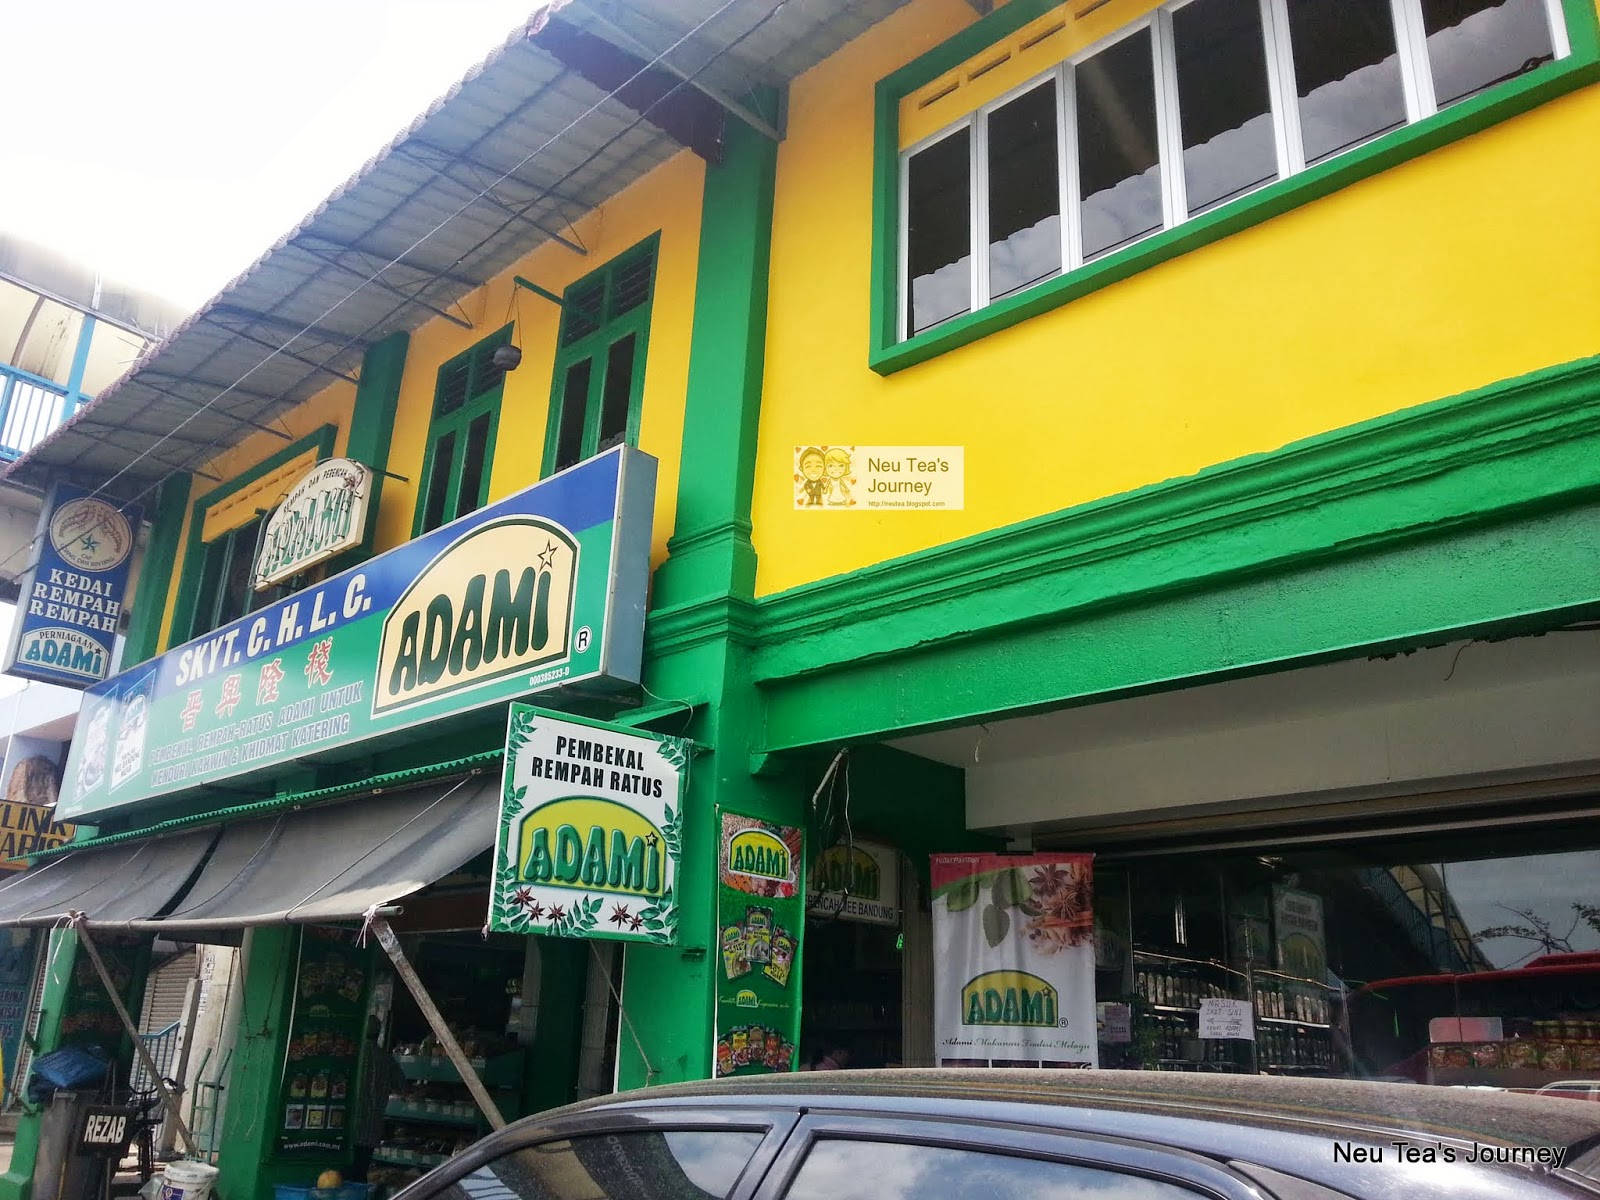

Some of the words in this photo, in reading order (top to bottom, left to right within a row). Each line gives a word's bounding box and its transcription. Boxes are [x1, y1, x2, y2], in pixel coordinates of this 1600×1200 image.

[308, 475, 320, 488] DAN
[33, 582, 120, 617] REMPAH
[49, 568, 113, 597] KEDAI
[28, 599, 117, 633] REMPAH
[389, 566, 551, 696] ADAMI
[25, 639, 102, 676] ADAMI
[39, 631, 95, 650] PERNIAGAAN
[279, 696, 315, 726] ADAMI
[320, 681, 363, 714] UNTUK
[231, 750, 239, 766] &
[241, 735, 288, 763] KHIDMAT
[291, 713, 350, 748] KATERING
[556, 735, 645, 771] PEMBEKAL
[531, 756, 605, 788] REMPAH
[609, 770, 663, 798] RATUS
[523, 823, 661, 893] ADAMI
[733, 843, 788, 879] ADAMI
[858, 903, 893, 919] BANDUNG
[966, 987, 1055, 1025] ADAMI
[1208, 1000, 1238, 1008] MASUK
[84, 1115, 126, 1143] REZAB
